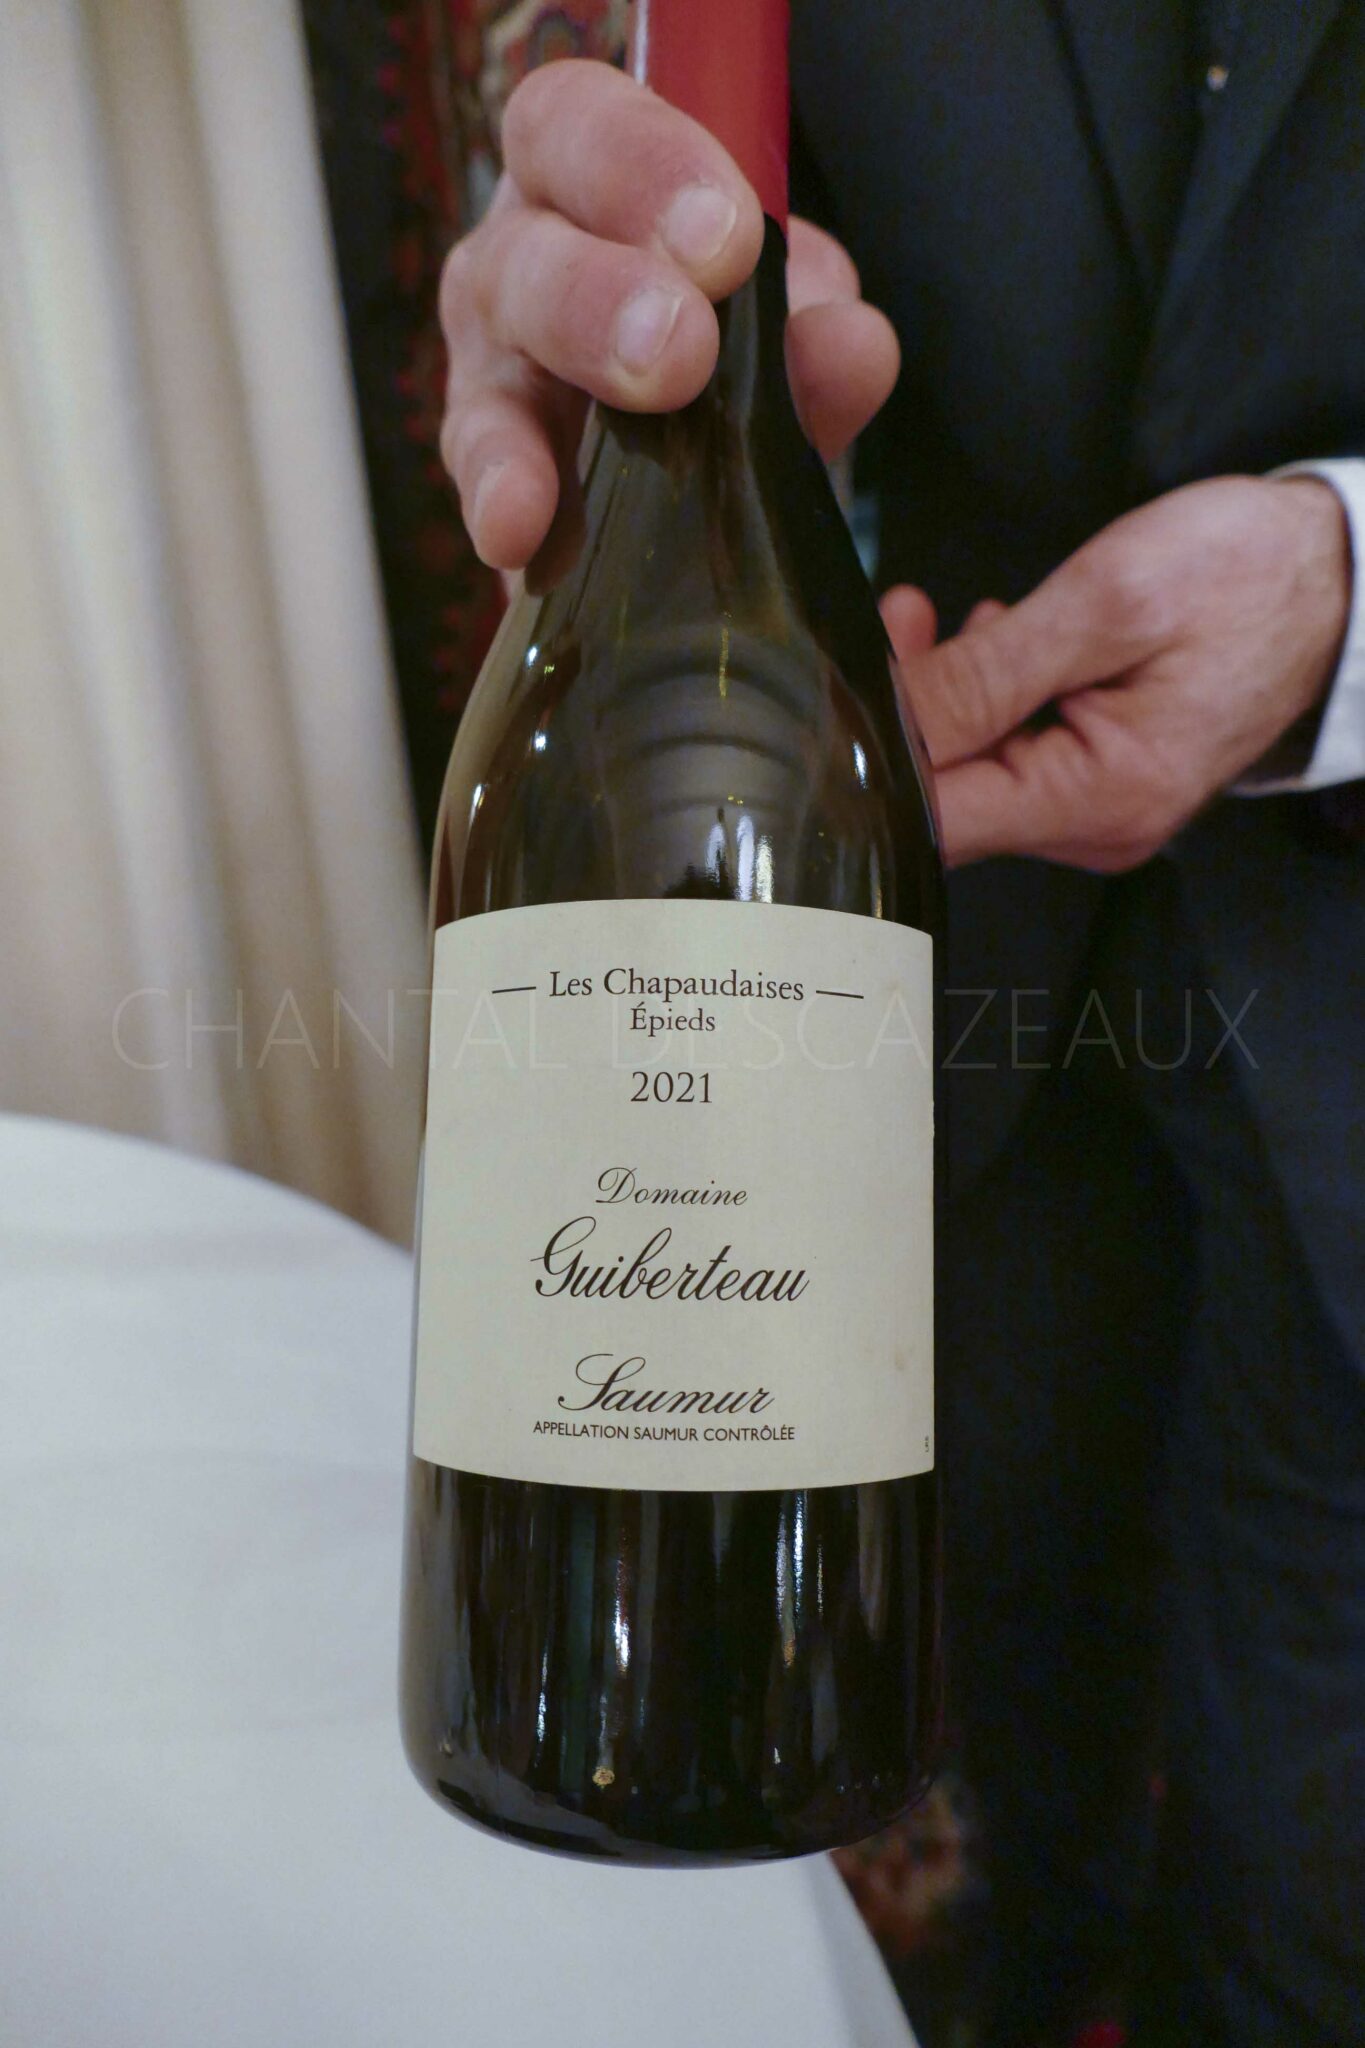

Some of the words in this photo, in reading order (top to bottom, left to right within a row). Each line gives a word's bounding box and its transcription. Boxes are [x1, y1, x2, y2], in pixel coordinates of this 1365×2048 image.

[548, 970, 593, 998] Les
[603, 967, 804, 1001] Chapaudaises
[629, 1002, 716, 1037] Épieds
[630, 1071, 712, 1104] 2021
[595, 1166, 748, 1206] Domaine
[530, 1215, 811, 1303] Guiberteau
[557, 1353, 775, 1414] Saumur
[532, 1420, 629, 1439] APPELLATION
[633, 1426, 699, 1441] SAUMUR
[703, 1424, 795, 1441] CONTRÔLÉE
